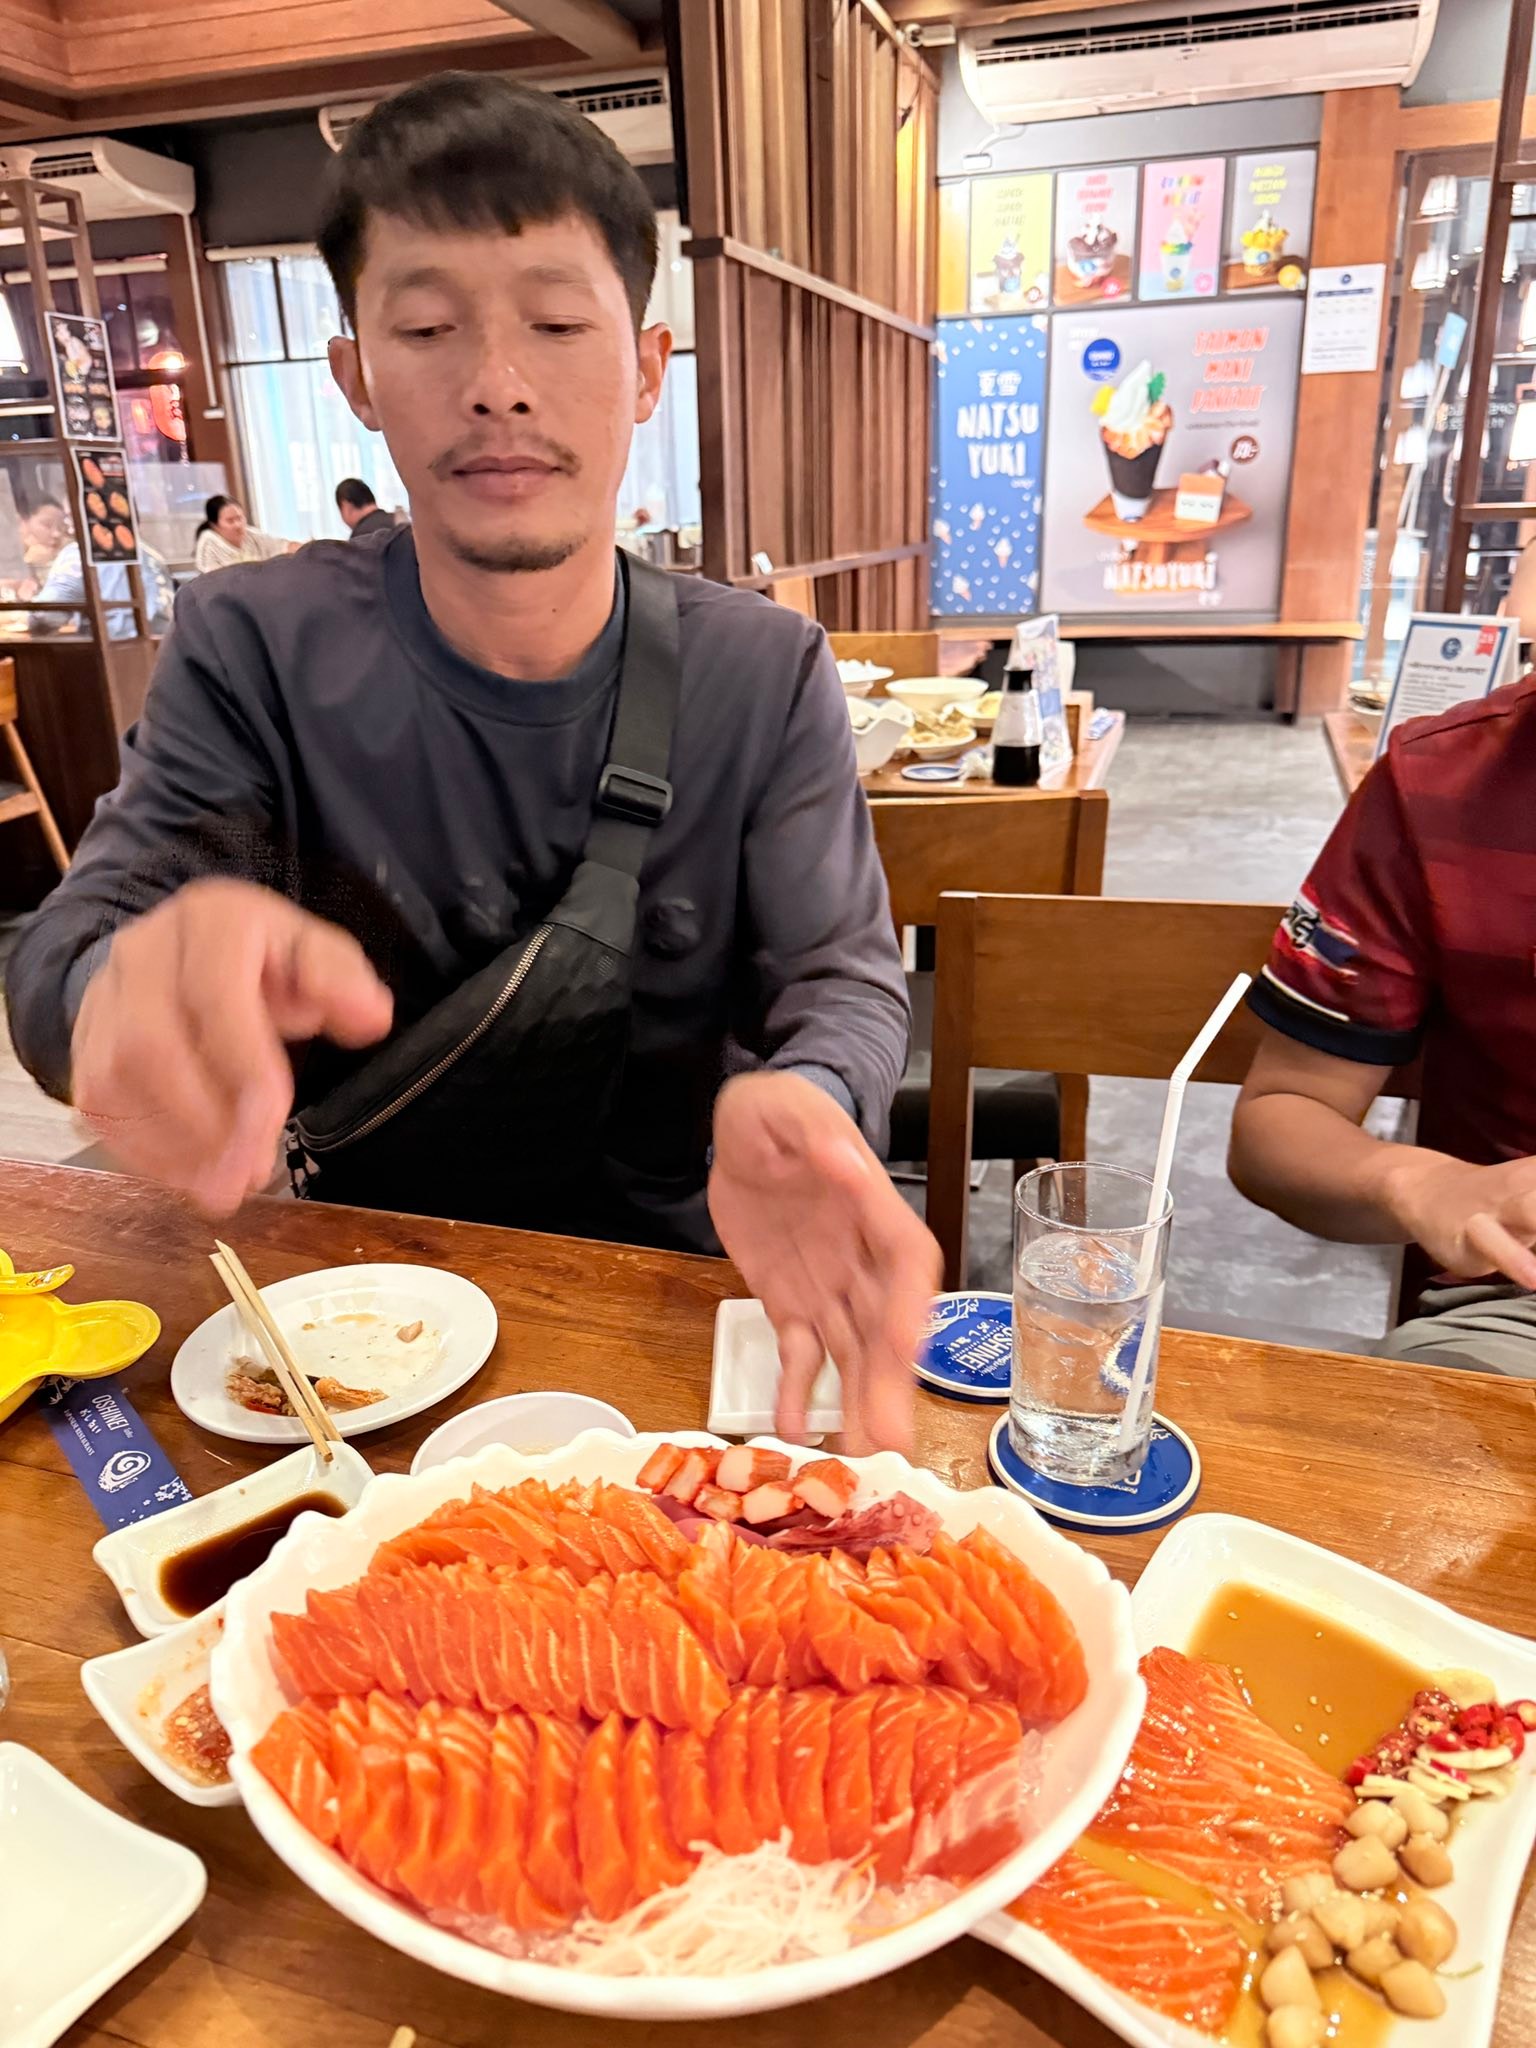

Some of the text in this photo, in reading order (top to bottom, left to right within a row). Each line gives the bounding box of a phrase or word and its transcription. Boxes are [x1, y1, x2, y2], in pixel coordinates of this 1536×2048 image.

[957, 402, 1039, 439] NATSU
[968, 441, 1026, 479] YUKI
[92, 1394, 129, 1431] OSHINEI
